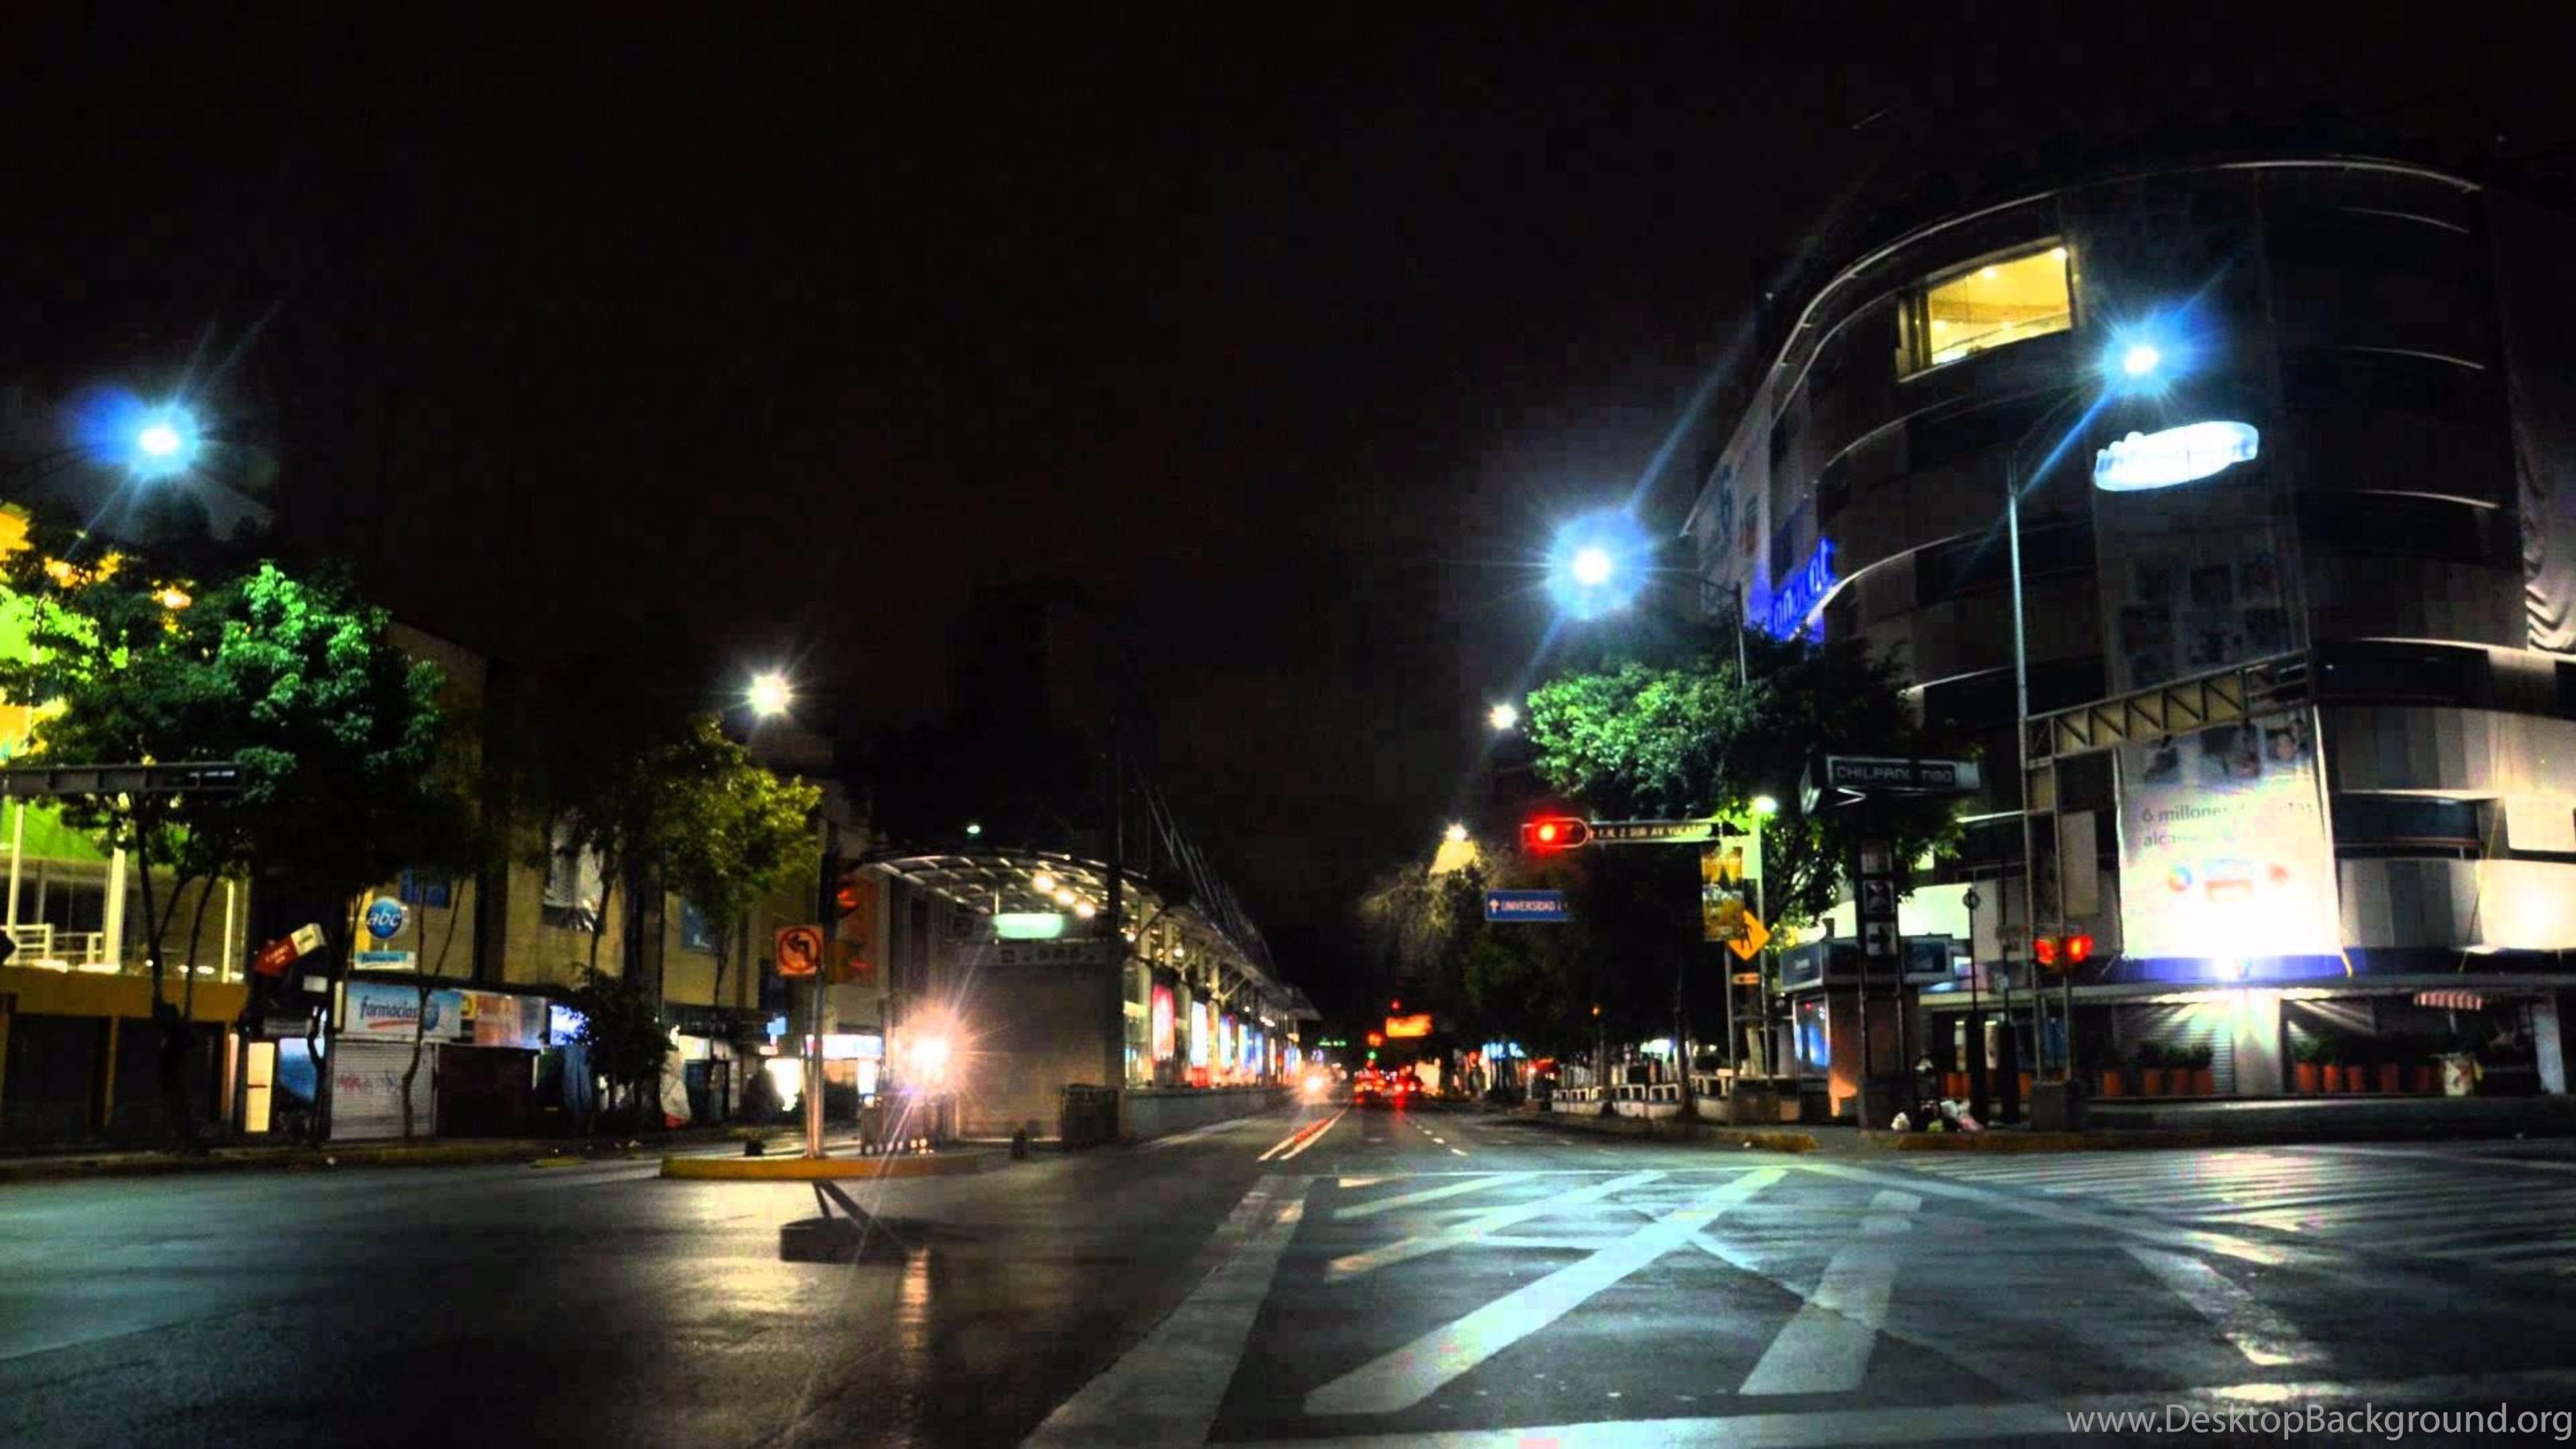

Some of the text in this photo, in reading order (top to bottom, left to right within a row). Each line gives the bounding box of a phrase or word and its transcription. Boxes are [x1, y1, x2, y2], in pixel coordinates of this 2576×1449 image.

[2142, 807, 2153, 822] 6
[1651, 826, 1664, 838] AV
[1501, 900, 1556, 912] UNIVERSIDAD
[367, 910, 401, 927] abc
